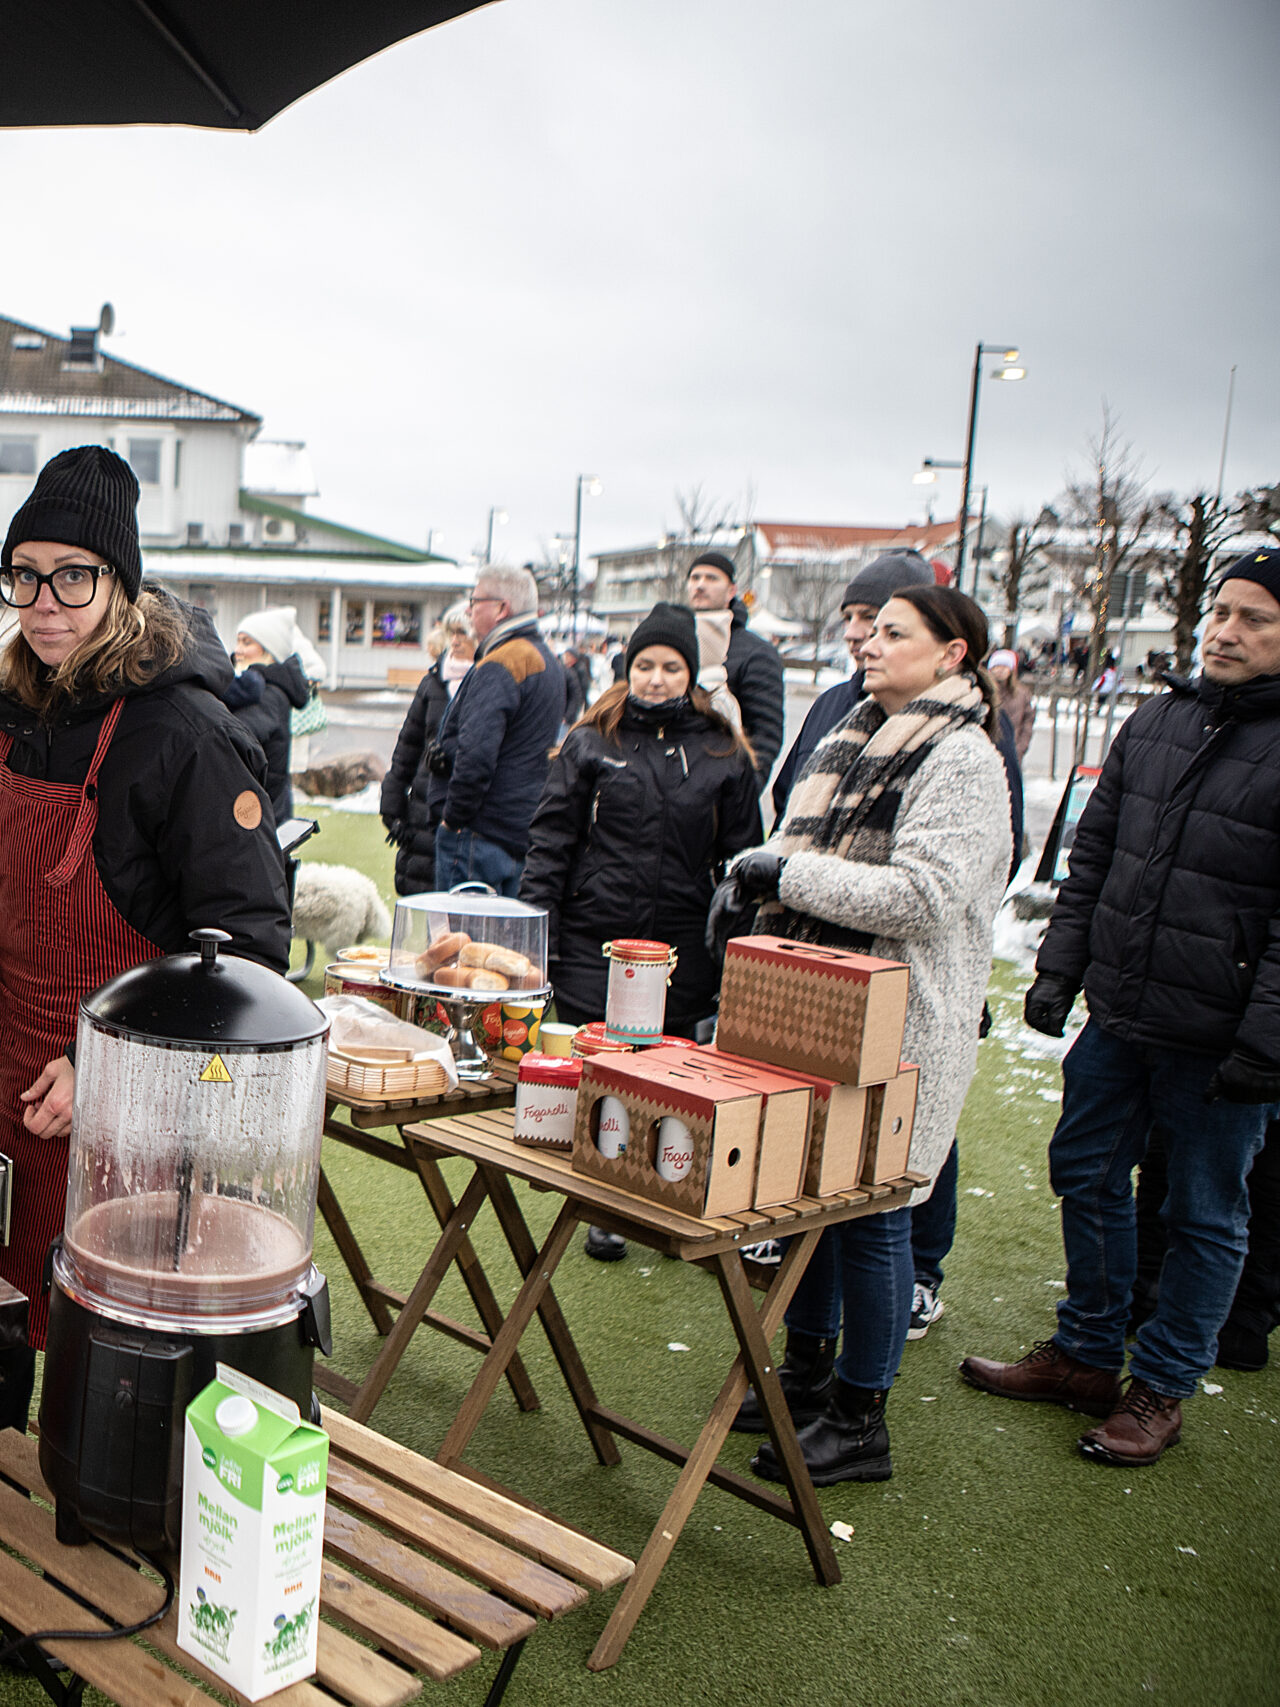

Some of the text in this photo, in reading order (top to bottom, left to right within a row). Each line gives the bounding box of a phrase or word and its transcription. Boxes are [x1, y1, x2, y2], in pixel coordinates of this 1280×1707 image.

[522, 1103, 569, 1123] Fogarolli
[220, 1463, 242, 1490] FRI
[297, 1469, 320, 1491] FRI
[198, 1491, 238, 1530] Mellan
[273, 1512, 317, 1538] Mellan
